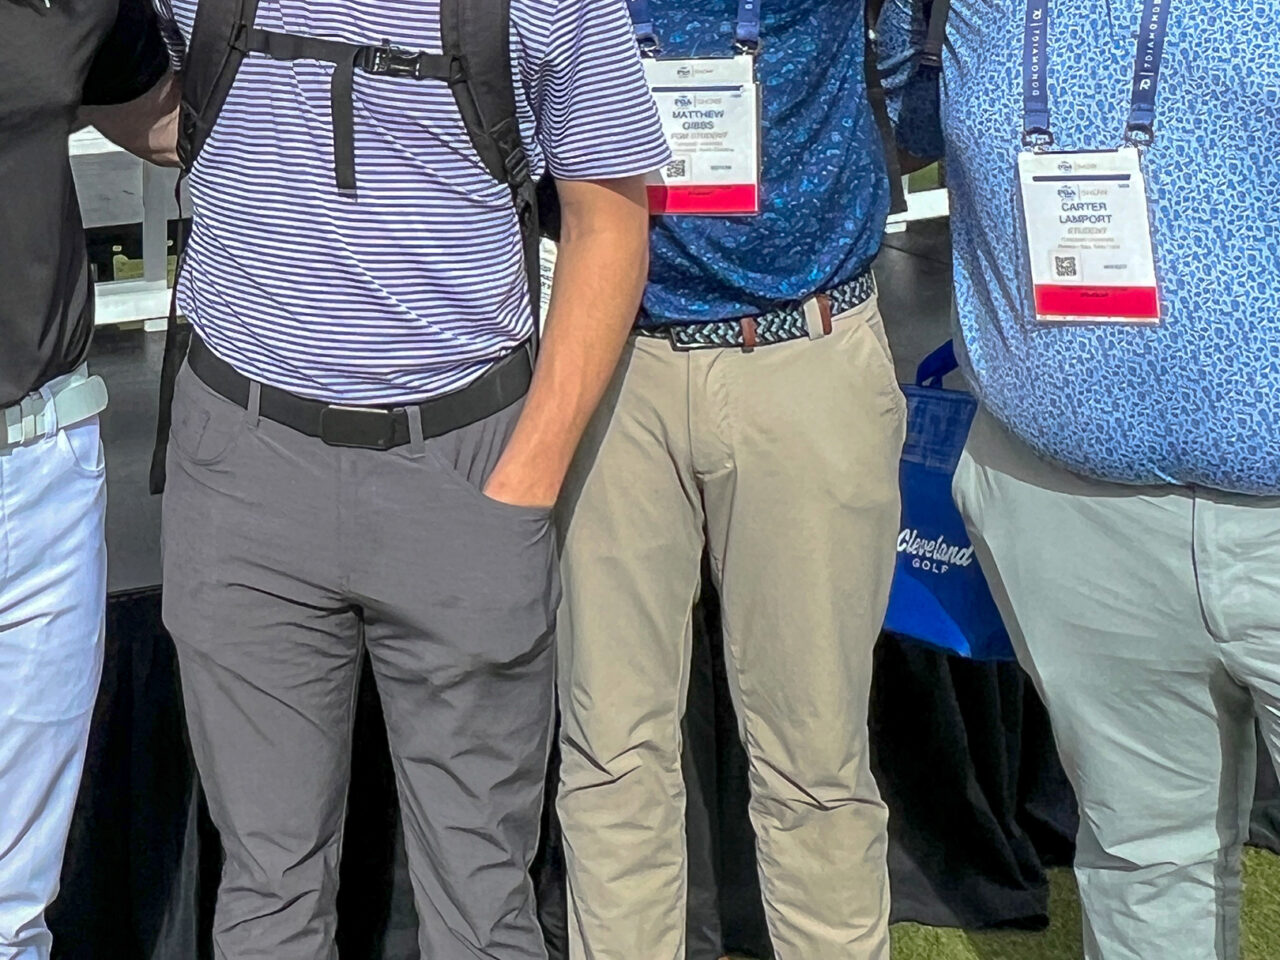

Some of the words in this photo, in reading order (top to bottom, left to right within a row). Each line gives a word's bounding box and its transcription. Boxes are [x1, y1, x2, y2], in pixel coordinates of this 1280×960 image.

[672, 109, 725, 119] MATTHEW
[682, 121, 714, 130] GIBBS
[1061, 202, 1107, 212] CARTER
[1059, 214, 1112, 224] LAMPORT
[896, 528, 975, 567] Cleveland
[912, 559, 949, 574] GOLF
